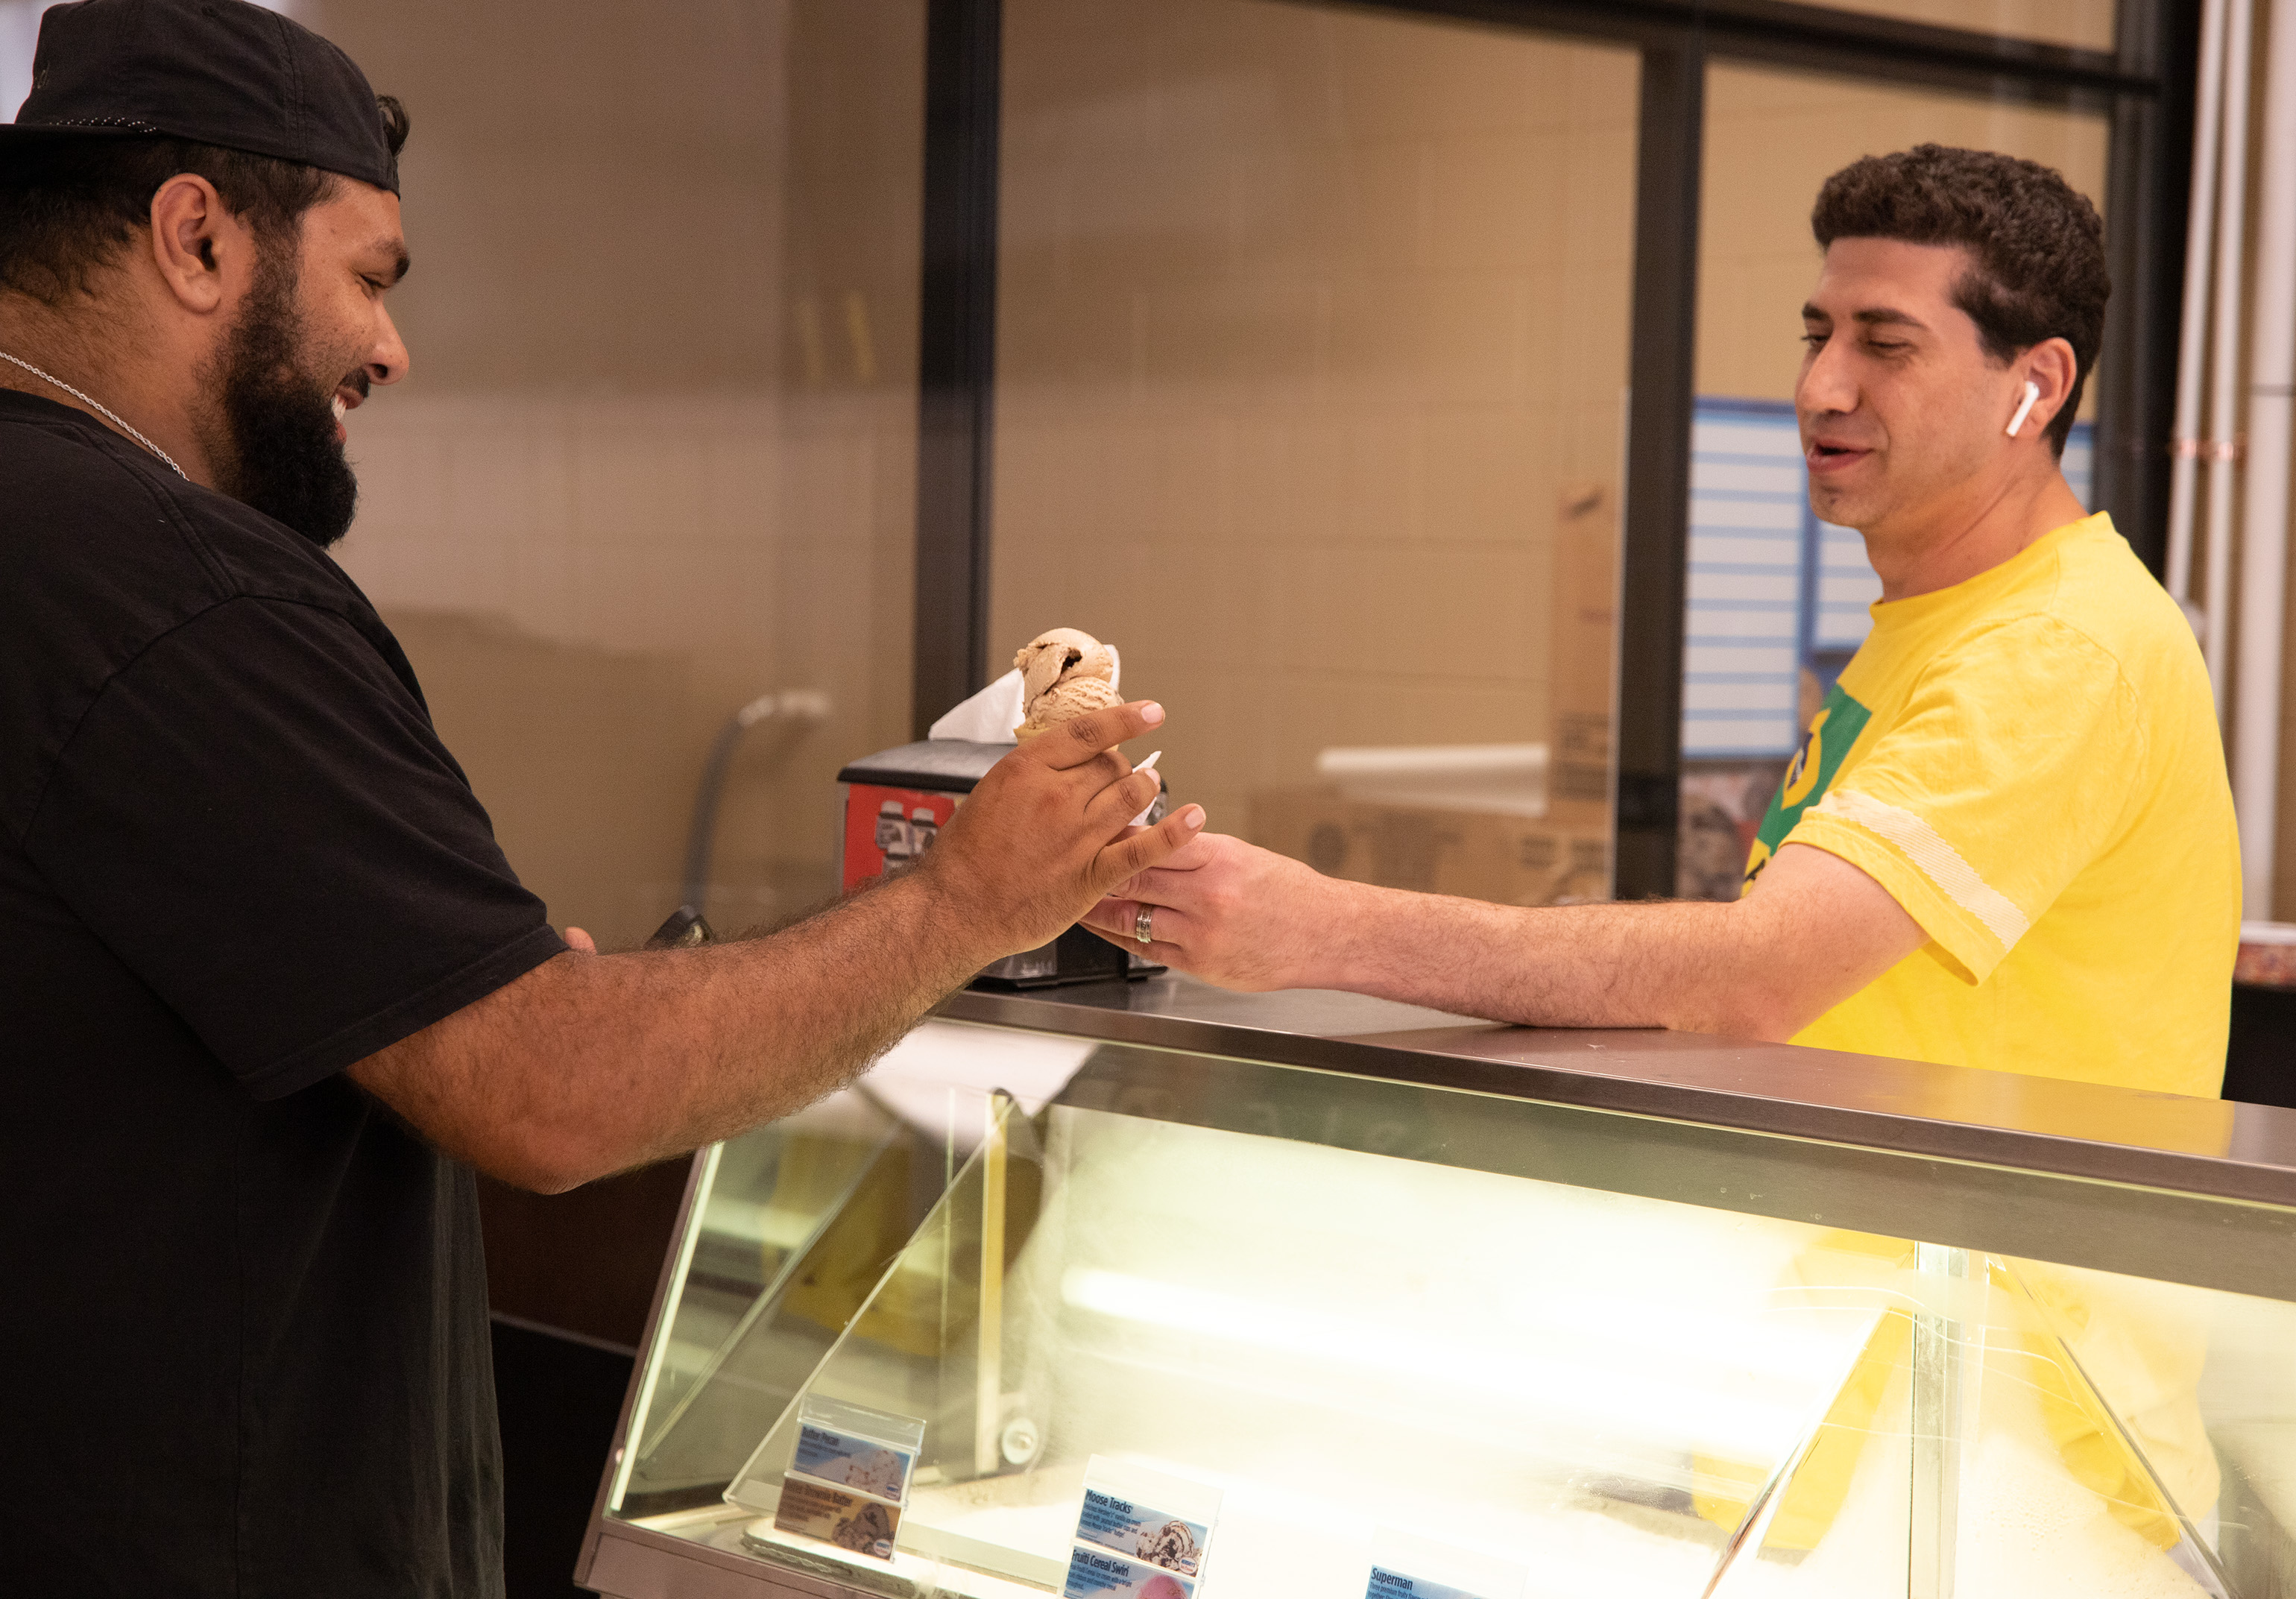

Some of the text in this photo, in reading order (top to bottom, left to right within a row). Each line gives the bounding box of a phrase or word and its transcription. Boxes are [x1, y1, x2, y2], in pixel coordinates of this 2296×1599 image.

[1085, 1489, 1108, 1506] Moose
[1091, 1555, 1111, 1571] Cereal
[1372, 1568, 1413, 1590] Superman
